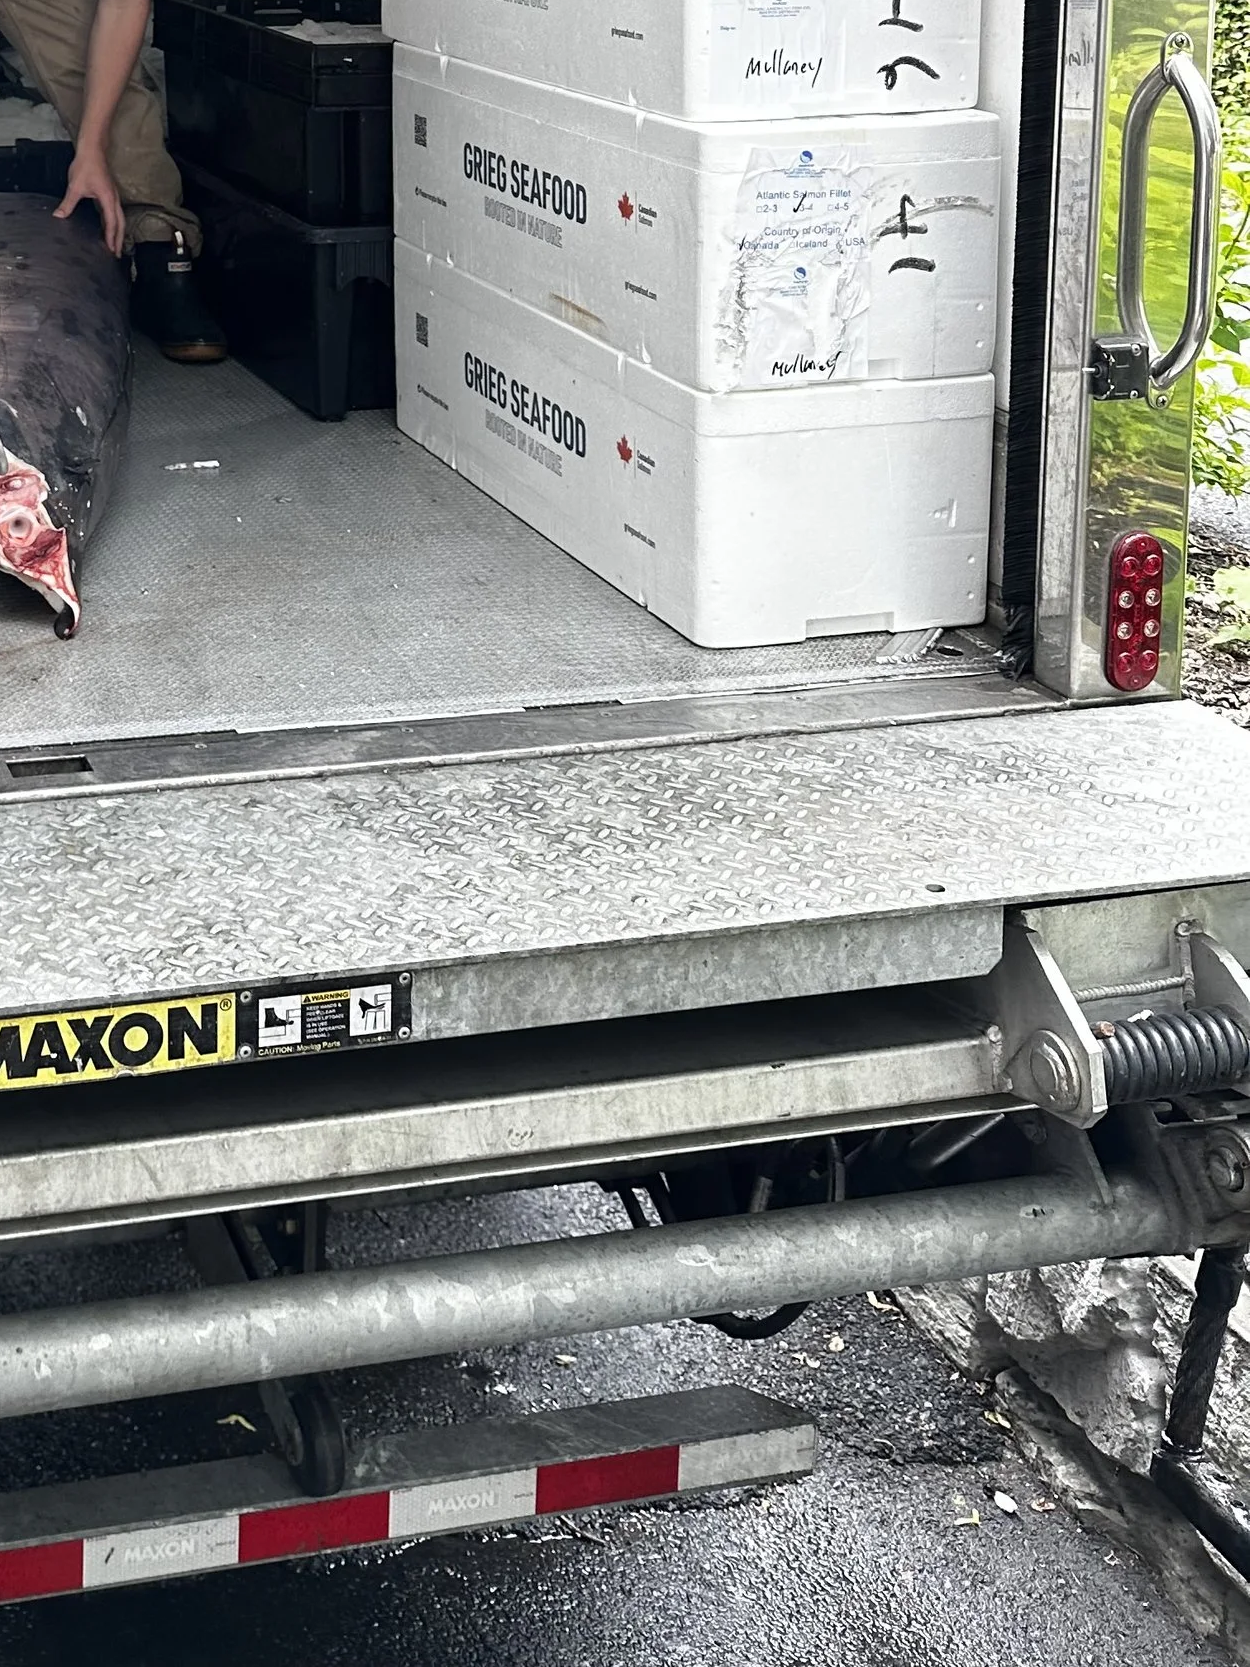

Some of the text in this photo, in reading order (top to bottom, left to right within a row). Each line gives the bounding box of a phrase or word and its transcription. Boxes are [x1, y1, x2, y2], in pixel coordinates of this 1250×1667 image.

[463, 143, 587, 224] GRIEG SEAFOOD
[756, 189, 851, 200] Atlantic Salmon Fillet
[484, 196, 515, 228] ROOTED
[528, 213, 563, 248] NATURE
[764, 225, 841, 238] Country of Origin
[744, 237, 866, 250] Canada Iceland USA
[464, 352, 586, 458] GRIEG SEAFOOD
[311, 991, 349, 1002] WARNING
[296, 1042, 322, 1053] Moving
[322, 1040, 342, 1049] Parts
[427, 1489, 495, 1517] MAXON
[124, 1537, 195, 1563] MAXON
